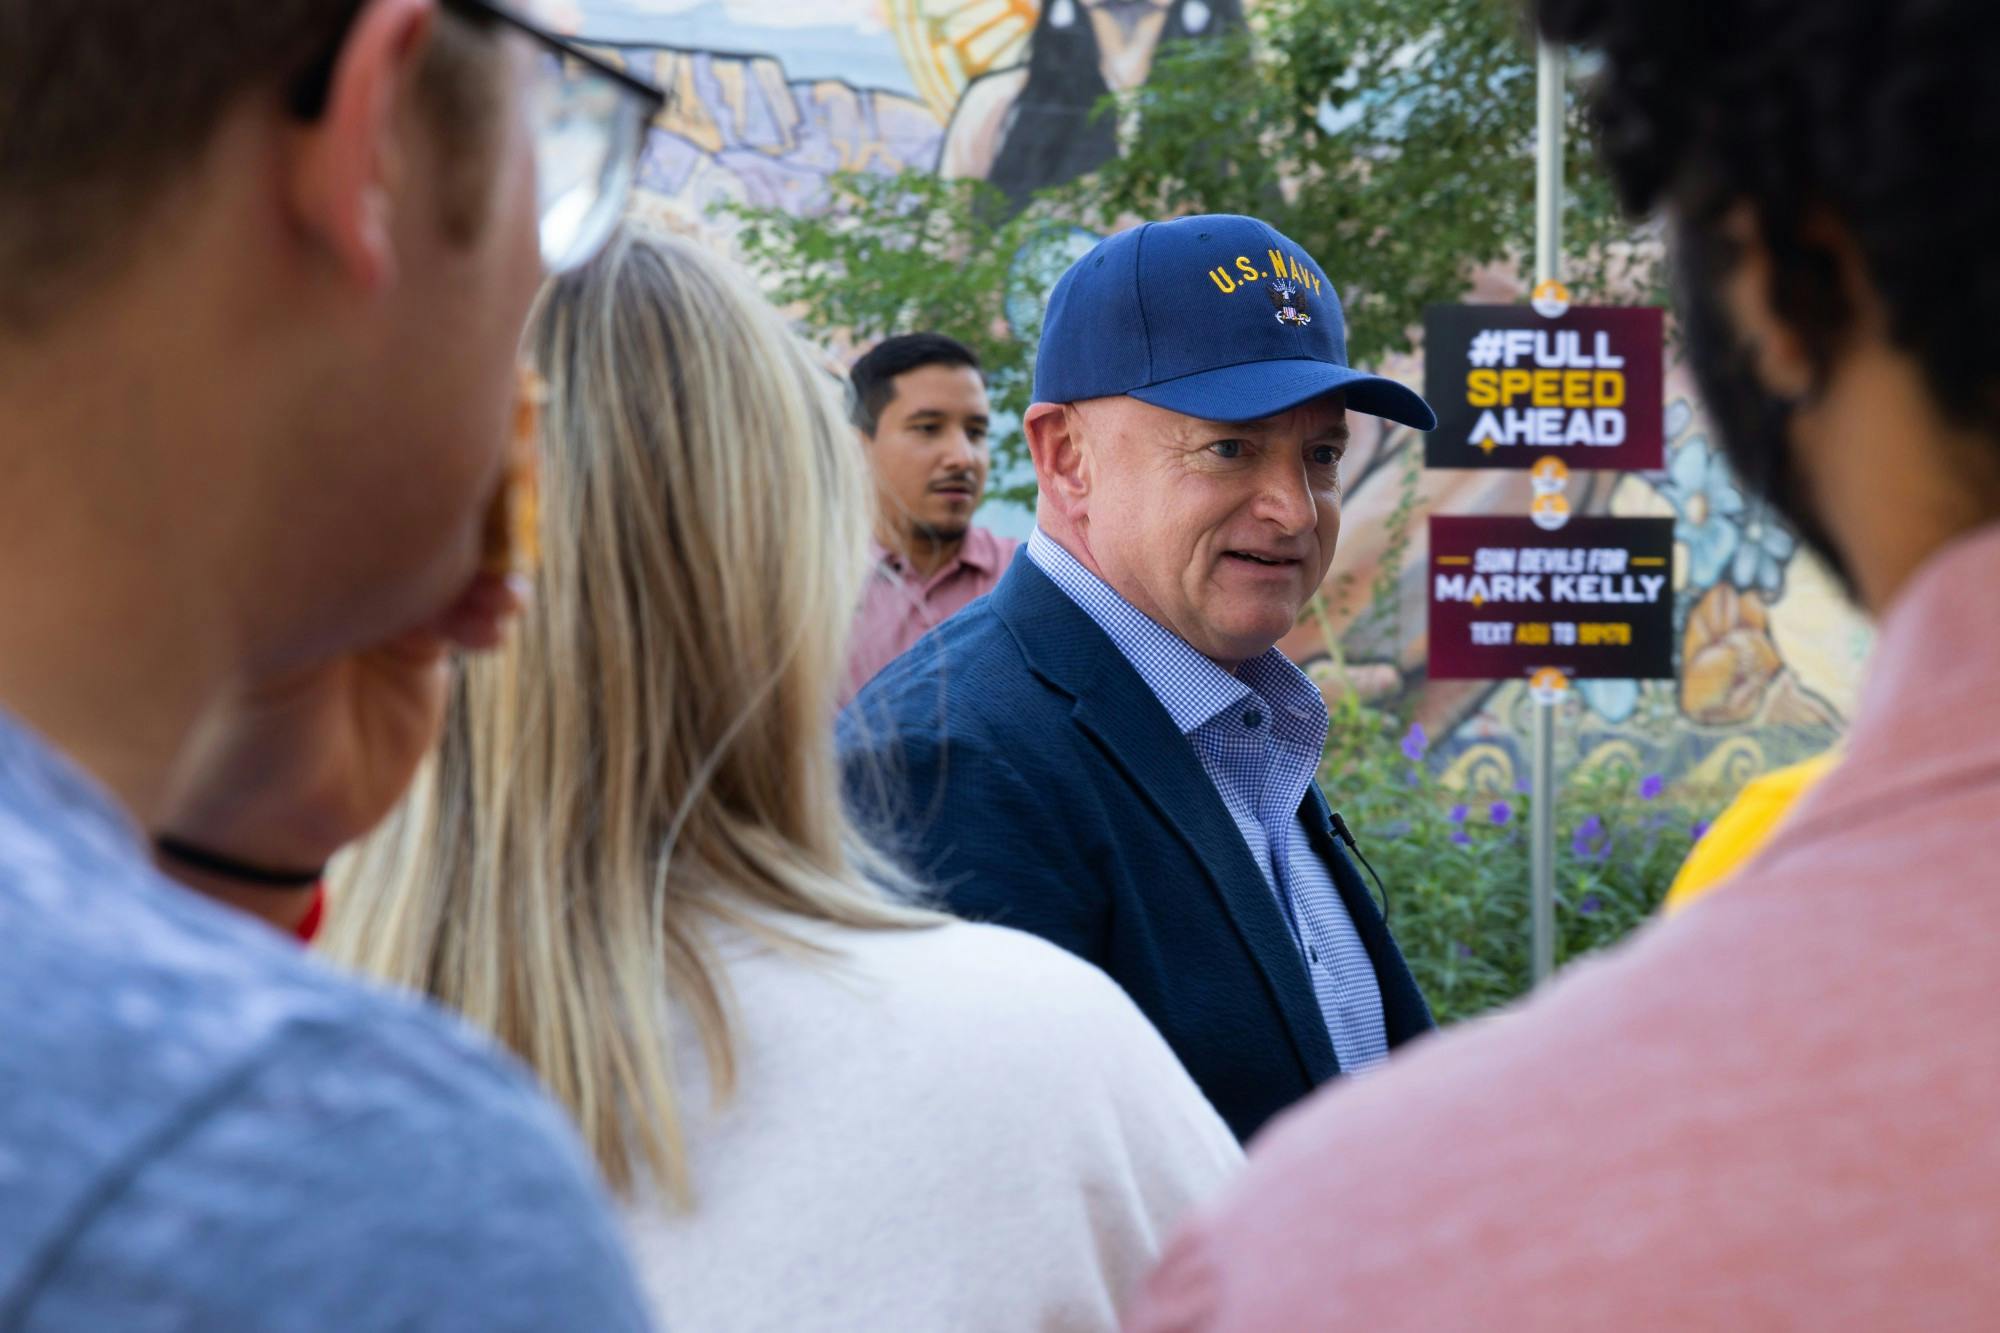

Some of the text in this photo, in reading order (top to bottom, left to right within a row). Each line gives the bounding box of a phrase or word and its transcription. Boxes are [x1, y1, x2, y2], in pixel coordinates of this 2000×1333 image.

[1209, 249, 1321, 297] U.S. NAVY
[1467, 329, 1625, 368] #FULL
[1466, 368, 1626, 407] SPEED
[1467, 407, 1627, 449] AHEAD
[1474, 548, 1629, 574] SUN DEVILS FOR
[1435, 573, 1666, 604] MARK KELLY
[1470, 621, 1514, 645] TEXT
[1552, 621, 1577, 645] TO
